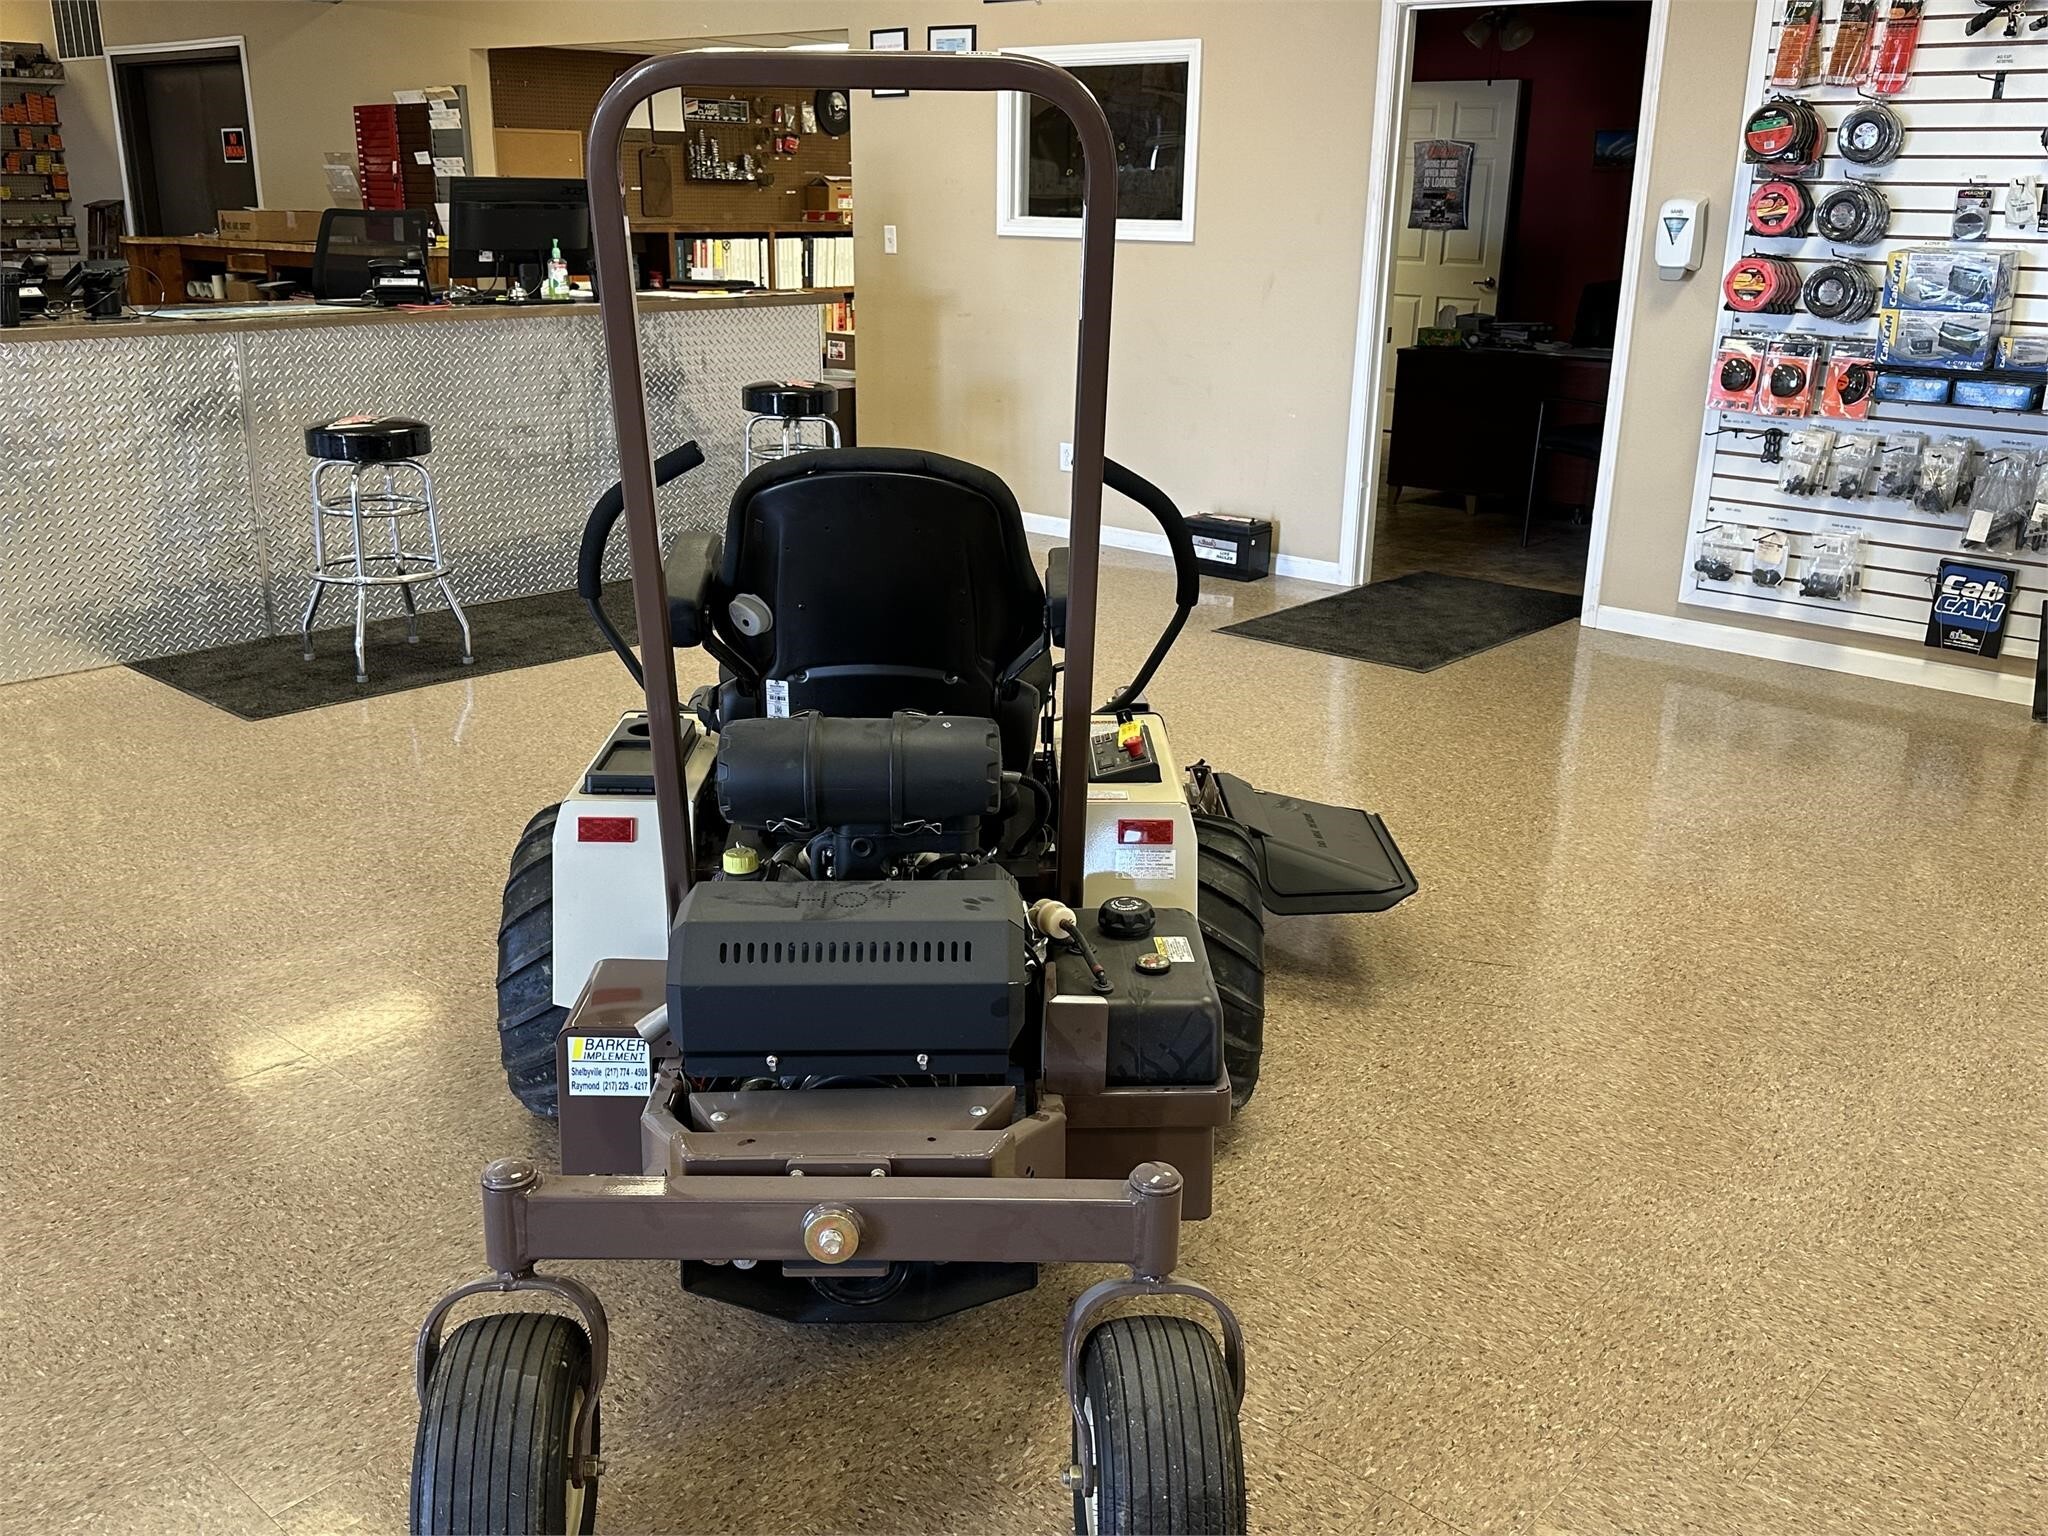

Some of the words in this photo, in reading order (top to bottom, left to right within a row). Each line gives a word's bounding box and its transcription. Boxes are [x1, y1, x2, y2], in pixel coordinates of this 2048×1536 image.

[1941, 574, 2005, 601] Cab
[1934, 594, 2006, 622] CAM
[795, 891, 906, 908] HOT
[585, 1038, 646, 1051] BARKER
[583, 1051, 645, 1061] IMPLEMENT
[571, 1067, 602, 1078] Shelbyville
[604, 1067, 619, 1078] (217)
[620, 1067, 630, 1077] 774
[571, 1081, 600, 1092] Raymond
[602, 1081, 618, 1092] (217)
[618, 1082, 629, 1090] 229
[634, 1081, 648, 1090] 4217
